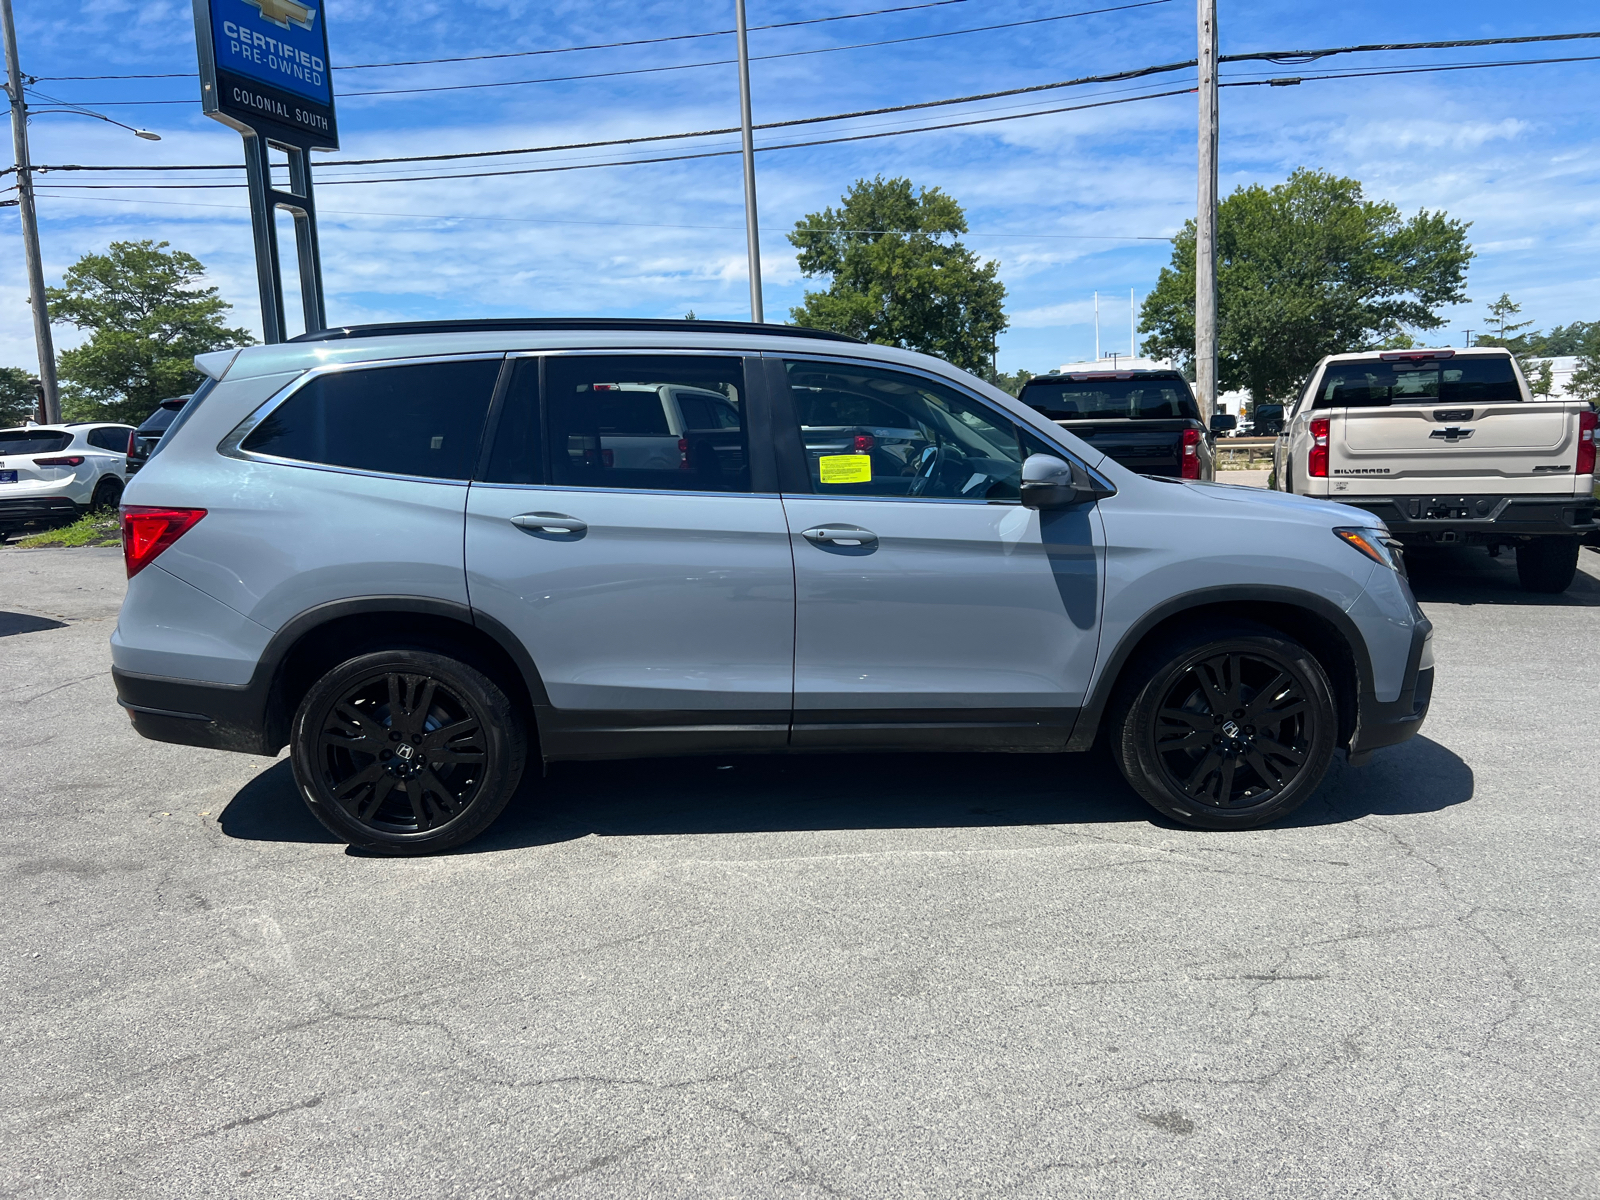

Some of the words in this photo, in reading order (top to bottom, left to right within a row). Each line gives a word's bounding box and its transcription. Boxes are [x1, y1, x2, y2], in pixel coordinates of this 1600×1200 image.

[223, 20, 324, 72] CERTIFIED
[230, 40, 322, 87] PRE-OWNED
[233, 87, 290, 118] COLONIAL
[295, 108, 328, 131] SOUTH
